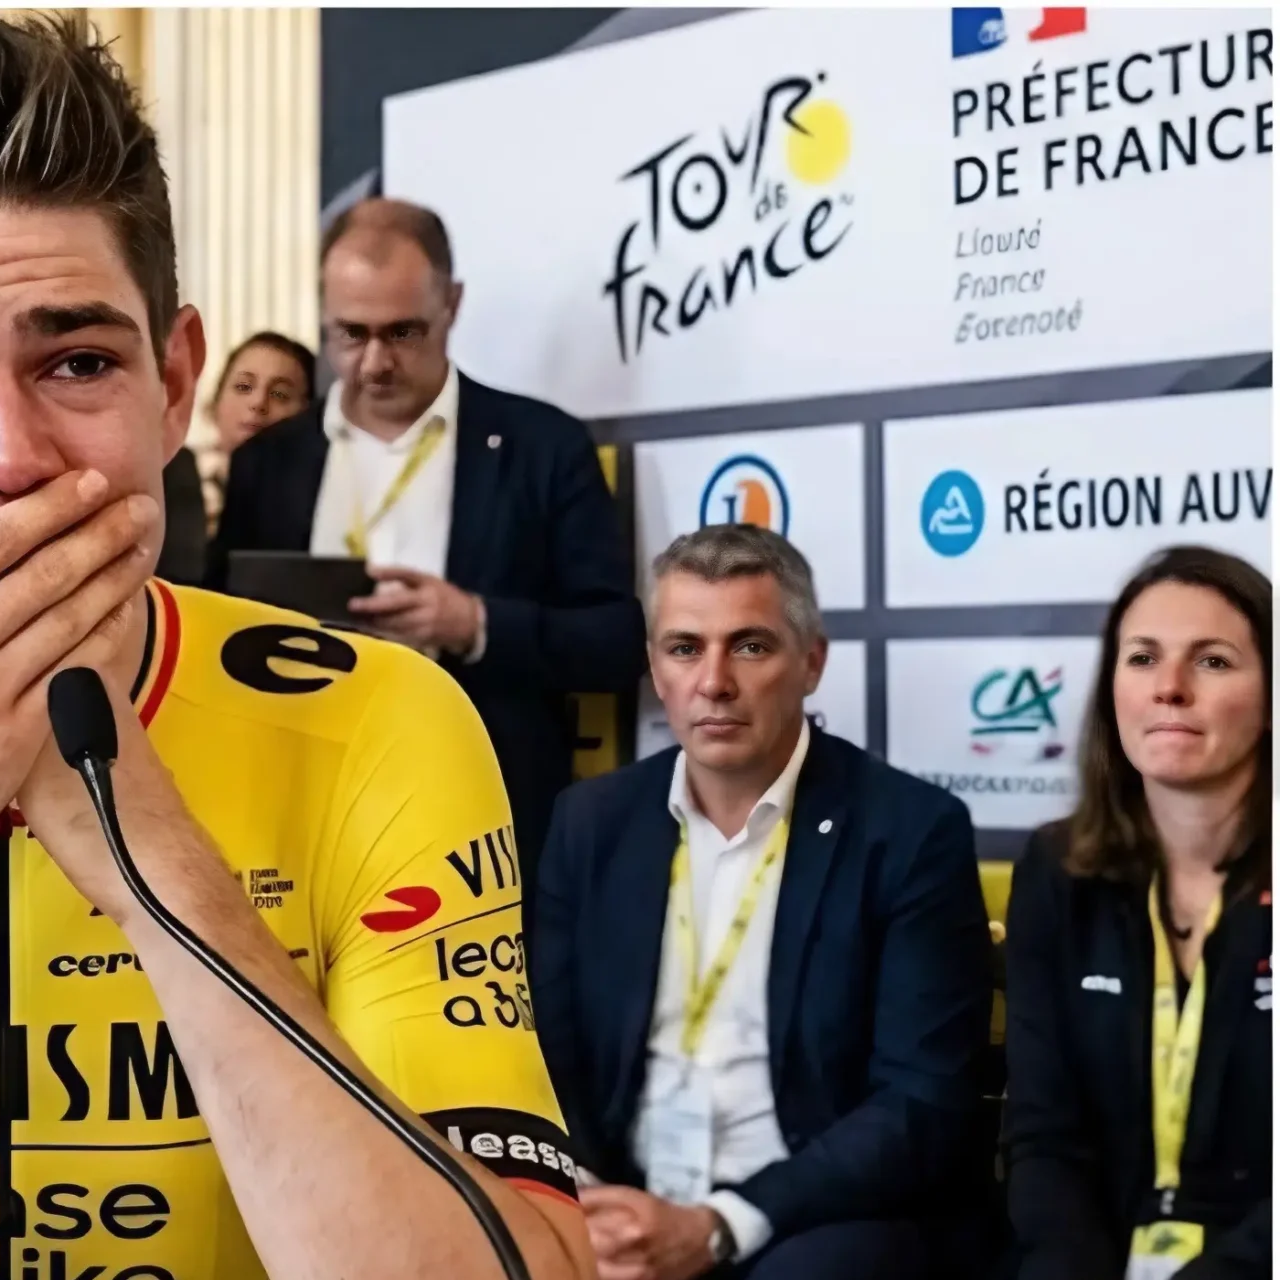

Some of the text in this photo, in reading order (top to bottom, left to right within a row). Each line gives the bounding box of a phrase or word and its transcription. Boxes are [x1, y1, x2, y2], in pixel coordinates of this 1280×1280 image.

[952, 27, 1273, 138] PRÉFECTUR
[616, 75, 816, 252] TOUR
[954, 100, 1273, 206] DE FRANCE
[1004, 467, 1274, 533] RÉGION AUV
